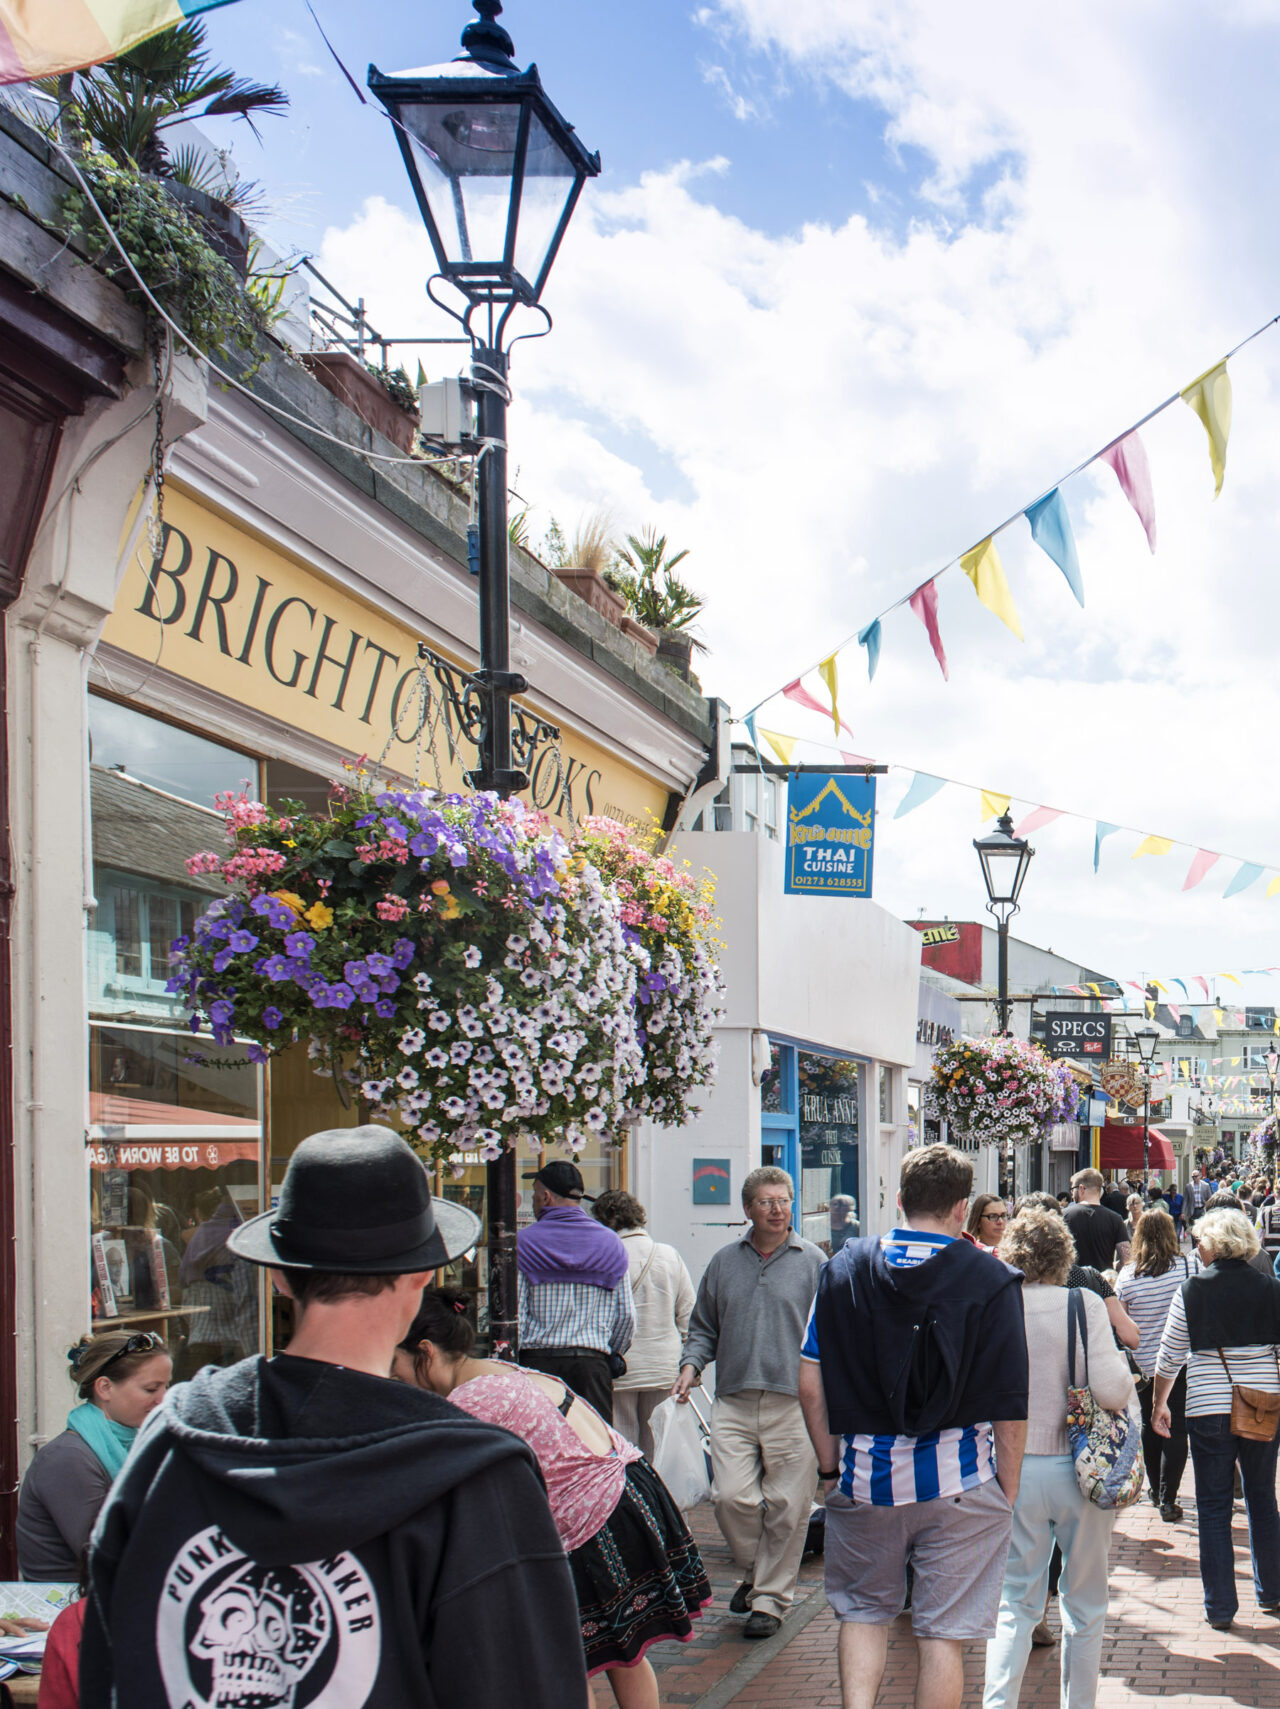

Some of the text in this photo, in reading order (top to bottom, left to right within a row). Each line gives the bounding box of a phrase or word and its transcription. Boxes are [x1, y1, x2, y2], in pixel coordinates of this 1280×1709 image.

[134, 520, 468, 766] BRIGHTON
[803, 846, 856, 862] THAI
[803, 861, 855, 873] CUISINE
[795, 876, 863, 888] 01273 628555
[1051, 1021, 1105, 1037] SPECS
[804, 1094, 857, 1125] KRUA ANNE
[168, 1531, 374, 1634] PUNK NKER
